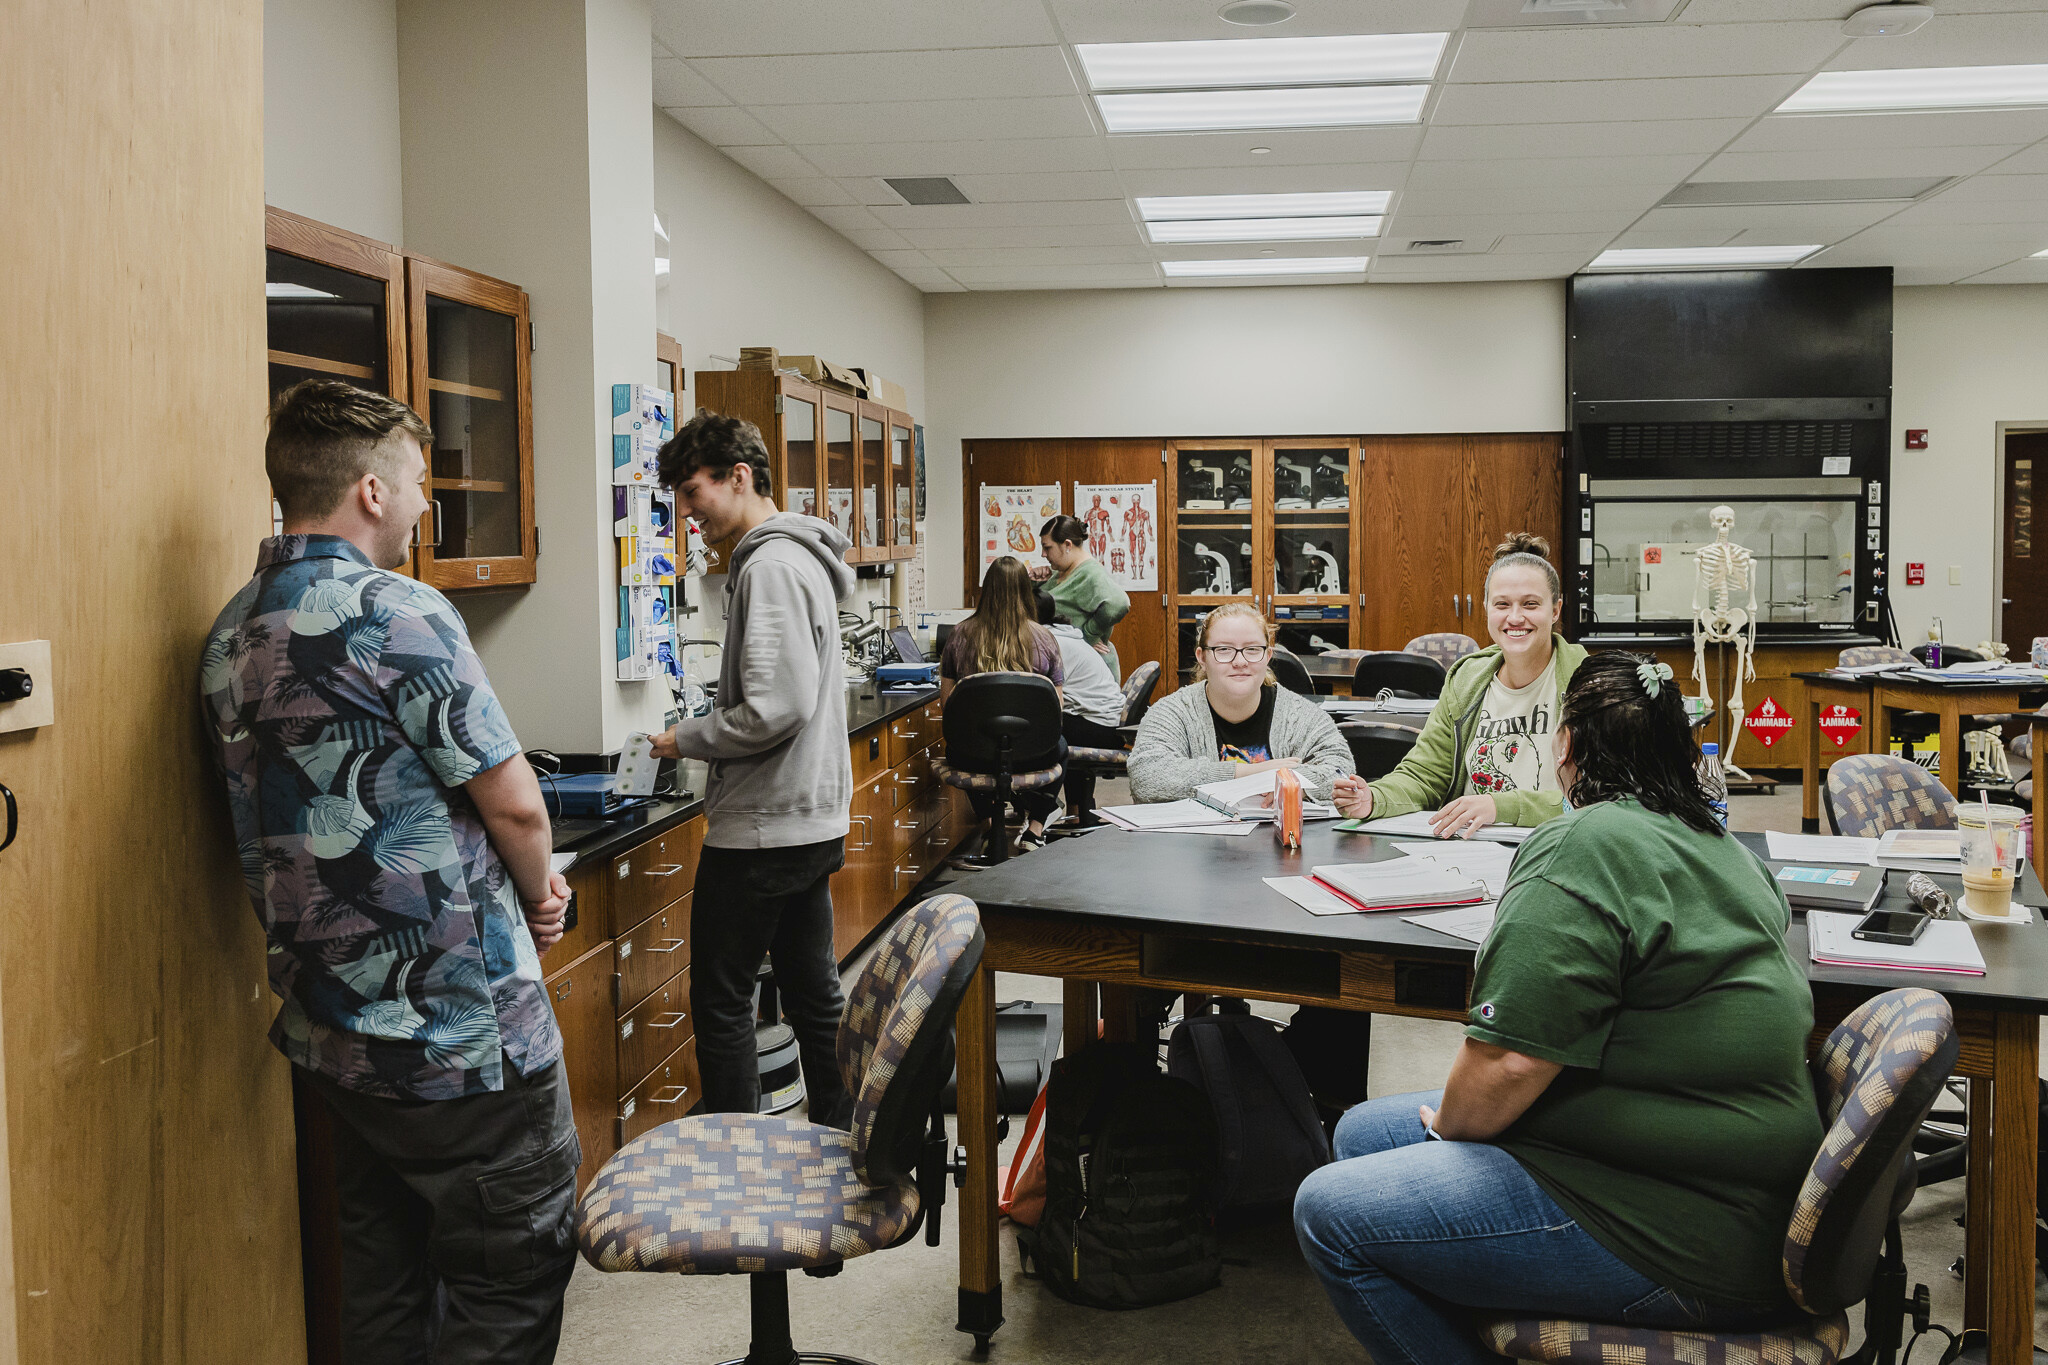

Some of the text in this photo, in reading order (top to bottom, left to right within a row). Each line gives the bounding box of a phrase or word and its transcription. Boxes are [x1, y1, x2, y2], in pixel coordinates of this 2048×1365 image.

[1745, 717, 1793, 727] FLAMMABLE
[1819, 717, 1861, 727] LAMMAB
[1765, 736, 1772, 746] 3
[1837, 736, 1843, 745] 3
